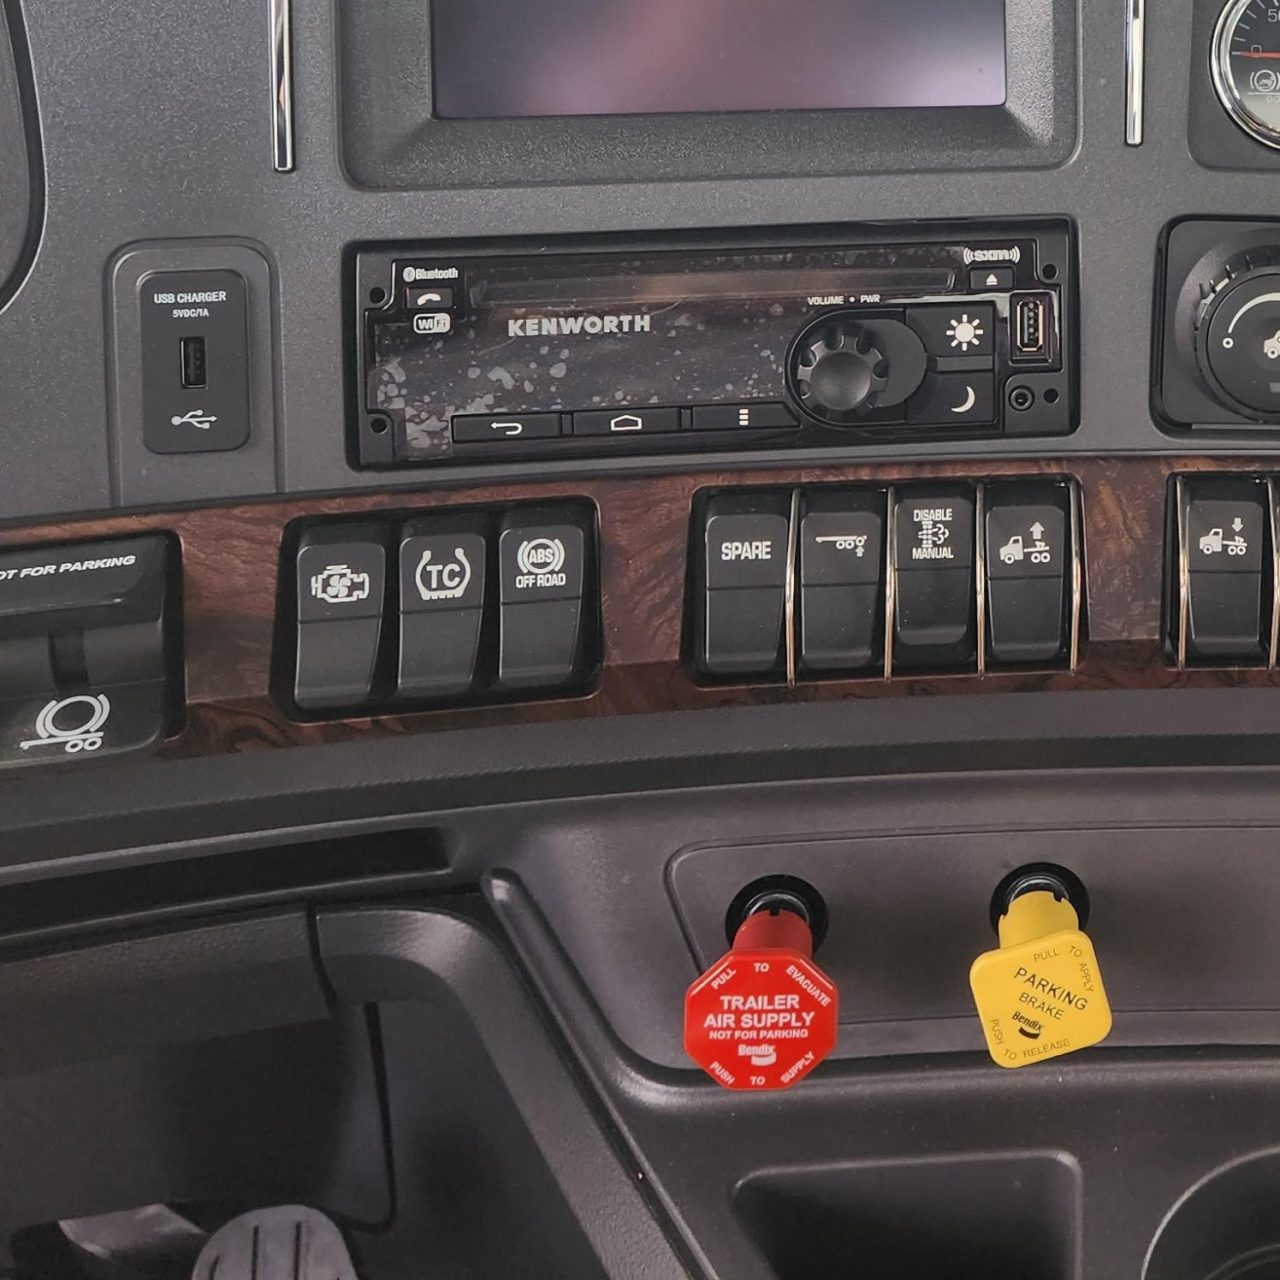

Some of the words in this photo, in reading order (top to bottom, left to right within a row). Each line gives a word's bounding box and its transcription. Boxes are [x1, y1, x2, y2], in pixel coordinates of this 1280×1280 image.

[415, 267, 458, 280] Bluetooth
[154, 293, 175, 304] USB
[177, 291, 226, 303] CHARGER
[808, 296, 844, 306] VOLUME
[860, 294, 880, 304] PWR
[508, 315, 650, 337] KENWORTH
[913, 509, 953, 522] DISABLE
[529, 548, 554, 564] ABS
[721, 541, 772, 561] SPARE
[912, 547, 954, 560] MANUAL
[20, 565, 56, 578] FOR
[59, 555, 136, 572] PARKING
[427, 564, 461, 589] TC
[516, 575, 536, 589] OFF
[537, 573, 566, 586] ROAD
[1033, 948, 1060, 963] PULL
[1069, 945, 1083, 958] TO
[1078, 962, 1094, 993] APPLY
[711, 967, 736, 990] PULL
[754, 962, 769, 973] TO
[786, 965, 831, 1007] EVACUATE
[1014, 967, 1088, 1011] PARKING
[720, 995, 800, 1011] TRAILER
[1019, 992, 1065, 1021] BRAKE
[704, 1014, 735, 1028] AIR
[741, 1011, 816, 1028] SUPPLY
[1011, 1011, 1044, 1031] Bendix
[710, 1030, 732, 1040] NOT
[735, 1030, 757, 1039] FOR
[760, 1029, 808, 1039] PARKING
[991, 1018, 1005, 1045] PUSH
[1004, 1048, 1017, 1061] TO
[1023, 1038, 1071, 1059] RELEASE
[738, 1044, 776, 1057] Bendix
[710, 1061, 736, 1085] PUSH
[750, 1076, 765, 1086] TO
[780, 1051, 815, 1084] SUPPLY
